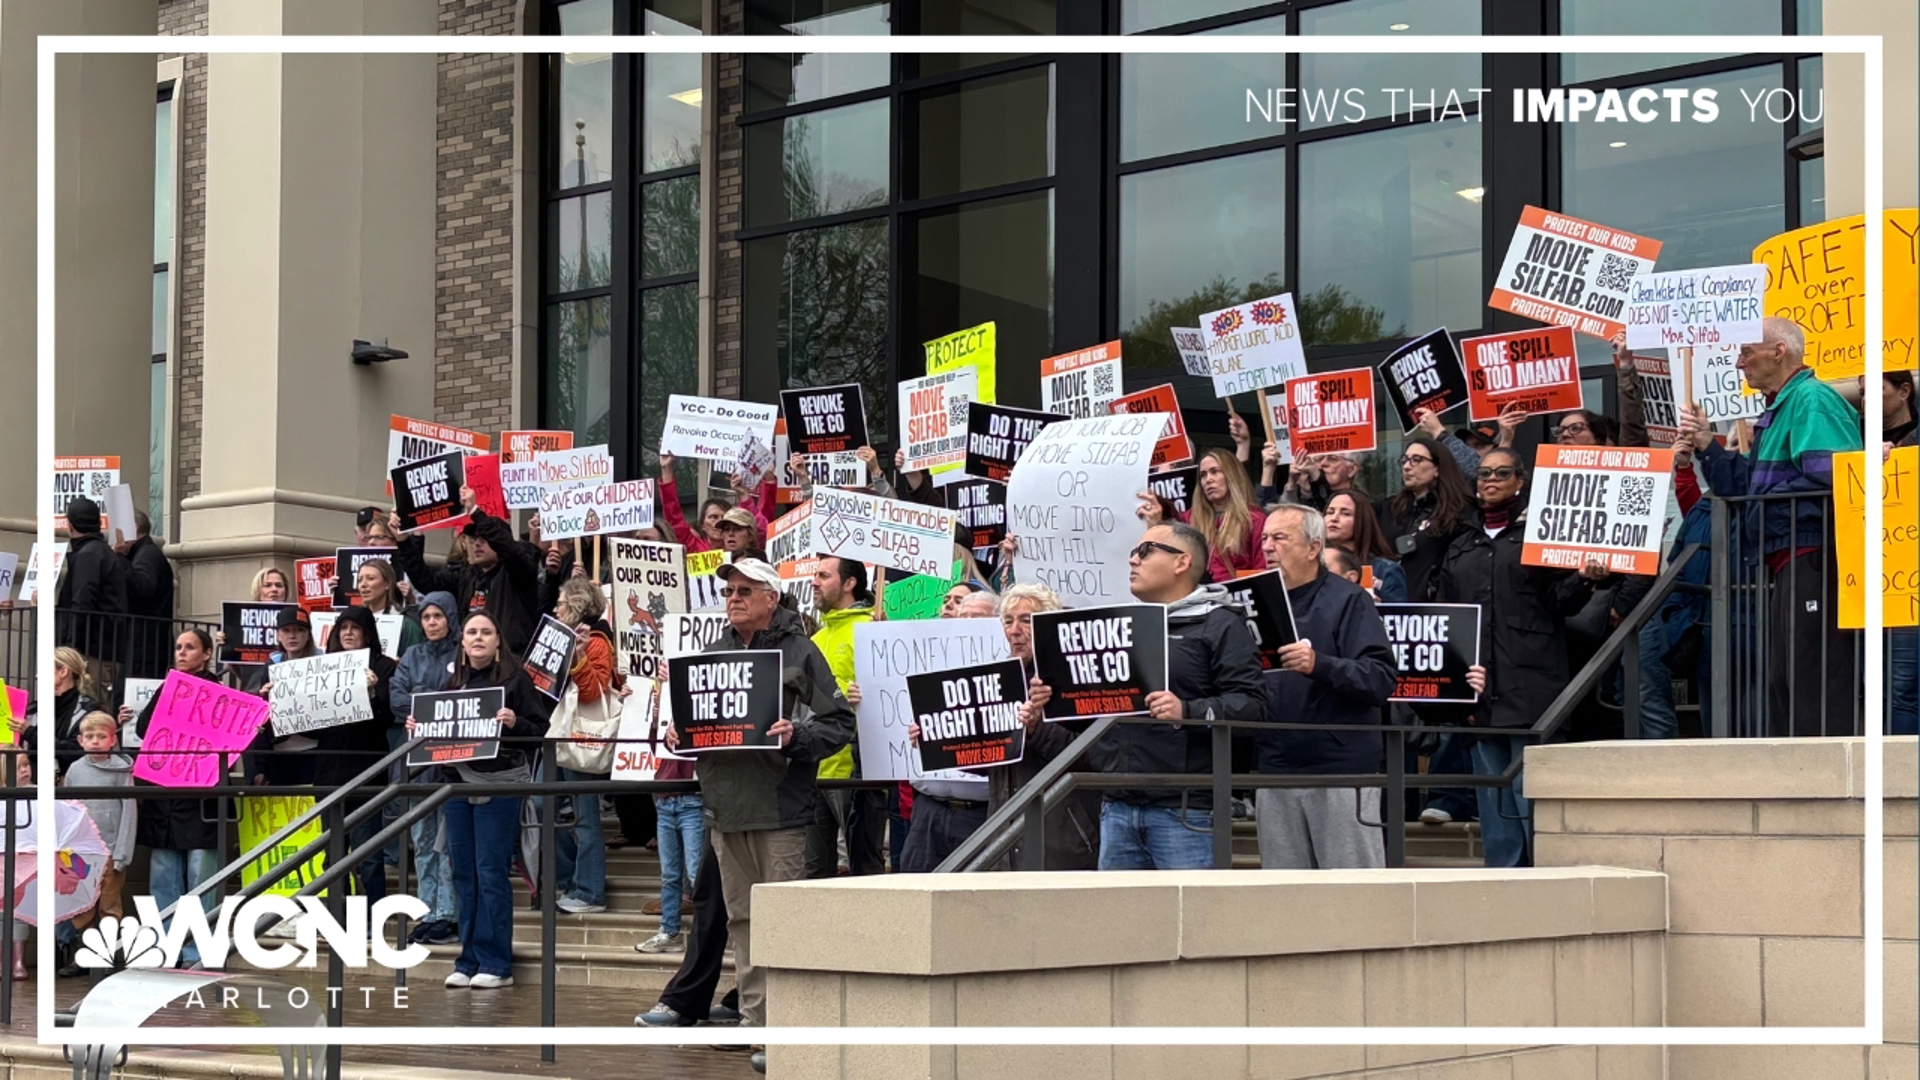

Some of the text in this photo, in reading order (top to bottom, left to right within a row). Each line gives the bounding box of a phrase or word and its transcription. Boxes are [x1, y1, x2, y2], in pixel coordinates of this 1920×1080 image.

[1542, 215, 1638, 251] PROTECT OUR KIDS
[1525, 233, 1594, 277] MOVE
[1510, 262, 1625, 320] SILFAB.COM
[1632, 278, 1697, 302] Clean Water Act
[1804, 276, 1855, 300] over
[1217, 307, 1278, 331] NO! NO!
[1510, 297, 1607, 337] PROTECT FORT MILL
[1628, 306, 1651, 326] DOES
[1651, 304, 1671, 325] NOT
[1681, 301, 1712, 325] SAFE
[1713, 297, 1760, 322] WATER
[1274, 322, 1294, 341] ACID
[1661, 325, 1721, 345] Move Silfab
[927, 328, 987, 372] PROTECT
[1053, 347, 1108, 372] PROTECT OUR KIDS
[1476, 335, 1554, 367] ONE SPILL
[1706, 355, 1732, 368] ARE
[1237, 362, 1297, 390] FORT MILL
[1390, 344, 1437, 385] REVOKE
[1471, 356, 1572, 391] IS TOO MANY
[1052, 371, 1087, 402] MOVE
[1294, 377, 1356, 406] ONE SPILL
[1399, 367, 1441, 405] THE CO
[680, 402, 770, 421] YCC Do Good
[799, 393, 845, 416] REVOKE
[910, 385, 945, 417] MOVE
[1289, 407, 1297, 428] IS
[1297, 403, 1321, 429] TOO
[1324, 398, 1369, 426] MANY
[407, 420, 474, 445] PROTECT OUR KIDS
[672, 425, 708, 438] Revoke
[804, 413, 846, 435] THE CO
[908, 412, 948, 444] SILFAB
[989, 413, 1010, 438] DO
[1043, 424, 1074, 440] DO
[1111, 416, 1148, 436] JOB
[510, 435, 560, 451] ONE SPILL
[937, 438, 950, 452] OUR
[969, 432, 1010, 460] RIGHT
[1028, 442, 1078, 465] MOVE
[538, 454, 610, 483] Move Silfab
[1557, 449, 1650, 469] PROTECT OUR KIDS
[406, 460, 448, 490] REVOKE
[502, 468, 525, 483] FLINT
[1057, 471, 1089, 498] OR
[410, 485, 433, 508] THE
[432, 481, 450, 502] CO
[541, 490, 572, 512] SAVE
[574, 492, 594, 506] OUR
[594, 480, 653, 506] CHILDREN
[957, 484, 989, 508] DO THE
[1546, 472, 1610, 508] MOVE
[541, 518, 558, 535] No
[556, 514, 583, 534] Toxic
[601, 512, 611, 528] in
[612, 507, 634, 527] Fort
[814, 491, 877, 520] explosive!
[880, 500, 954, 535] flammable!
[973, 503, 1005, 527] THING
[1013, 503, 1115, 533] MOVE INTO
[1537, 507, 1648, 548] SILFAB.COM
[617, 543, 673, 564] PROTECT
[852, 527, 921, 556] @ SILFAB
[1062, 537, 1105, 565] HILL
[301, 563, 318, 580] ONE
[892, 553, 939, 576] SOLAR
[1541, 549, 1636, 571] PROTECT MILL
[304, 579, 321, 597] TOO
[616, 567, 678, 588] OUR CUBS
[1035, 568, 1112, 597] SCHOOL
[1846, 573, 1857, 587] a
[242, 628, 262, 645] THE
[620, 631, 647, 653] MOVE
[1057, 616, 1134, 654] REVOKE
[547, 650, 563, 675] CO
[1066, 650, 1130, 685] THE CO
[1414, 643, 1444, 672] CO
[304, 669, 356, 694] FIX IT!
[688, 662, 753, 693] REVOKE
[941, 673, 1003, 709] DO THE
[1403, 683, 1438, 698] SILFAB
[270, 688, 353, 719] Revoke The CO
[434, 697, 481, 721] DO THE
[691, 691, 748, 721] THE CO
[1075, 695, 1134, 715] MOVE SILFAB
[414, 718, 497, 738] RIGHT THING
[919, 700, 1024, 742] RIGHT THING
[713, 730, 743, 746] SILFAB
[147, 727, 213, 785] OUR
[956, 748, 981, 766] MOVE
